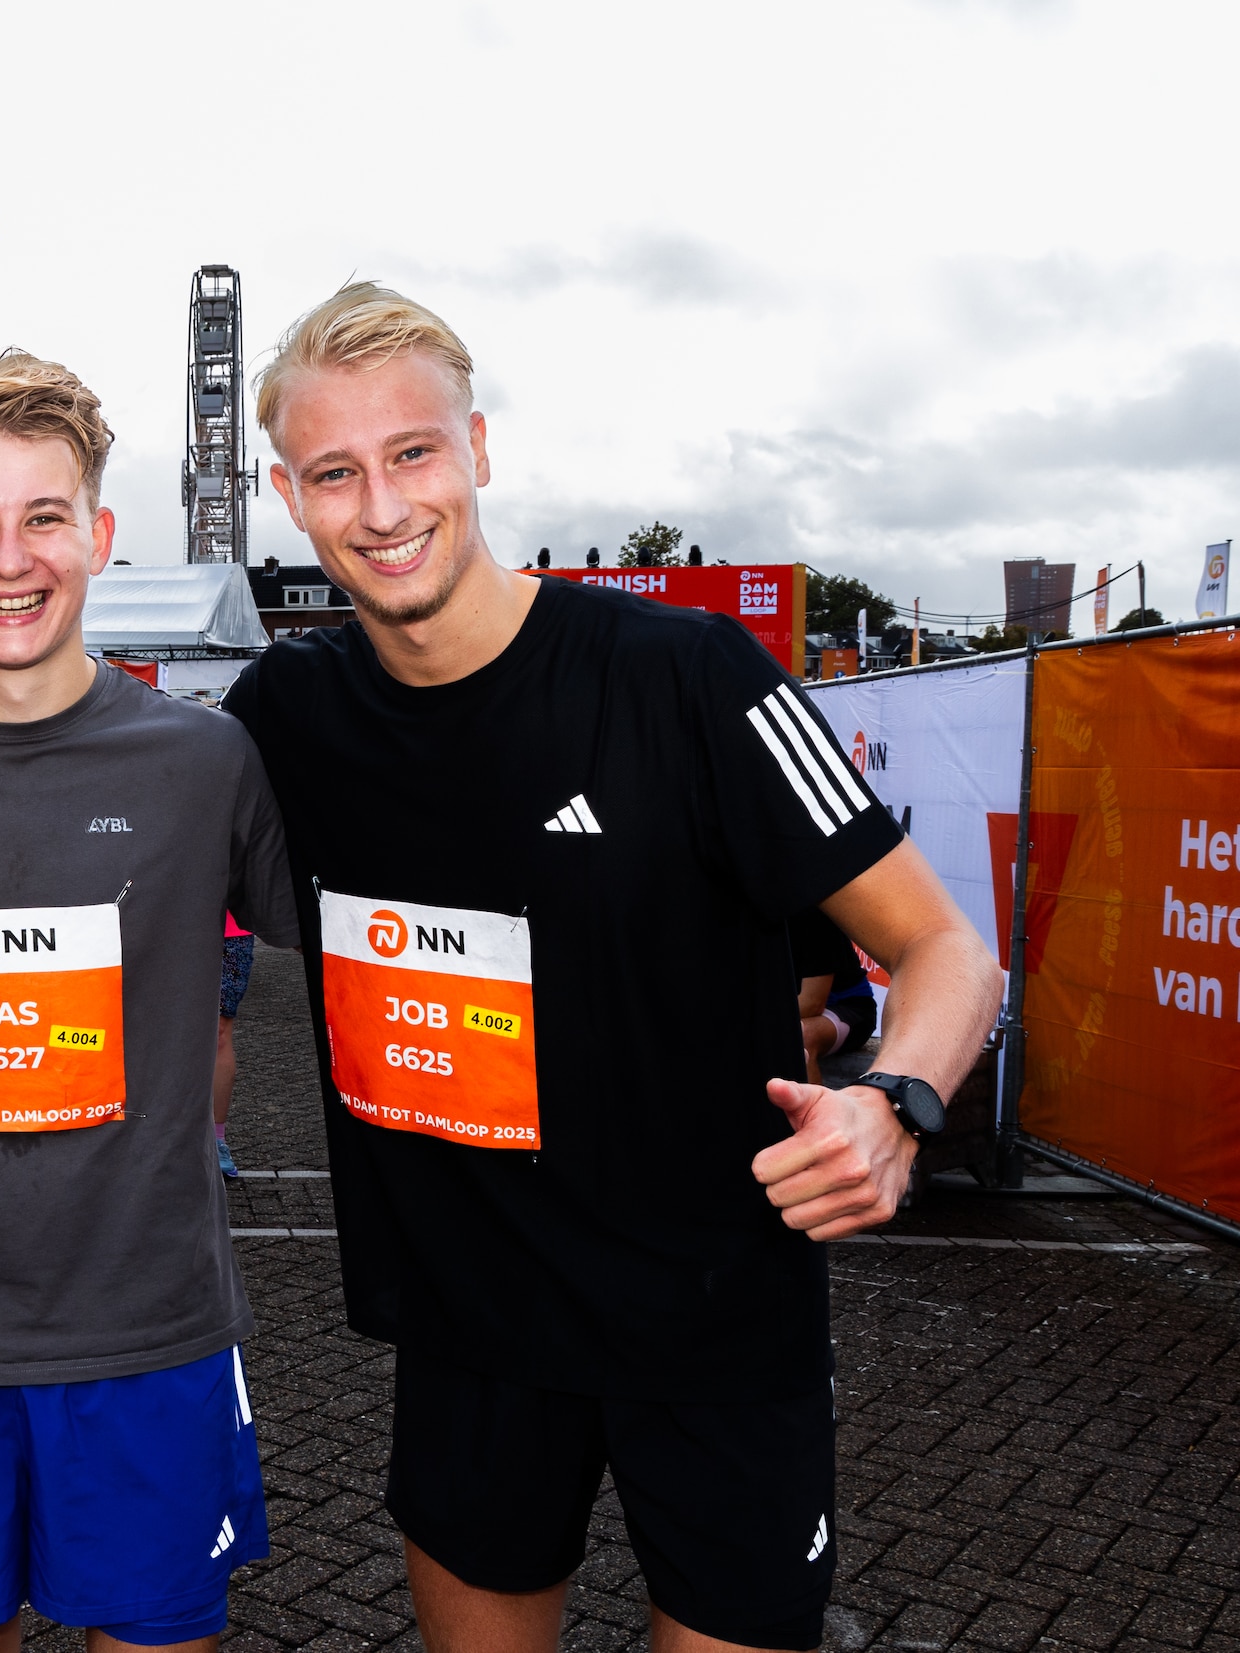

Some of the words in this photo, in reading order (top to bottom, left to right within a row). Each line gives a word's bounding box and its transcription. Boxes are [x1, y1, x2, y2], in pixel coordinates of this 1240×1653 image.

[582, 575, 666, 593] FINISH
[739, 583, 778, 595] DAM
[739, 595, 778, 606] DAM
[867, 742, 887, 771] NN
[2, 927, 57, 953] NN
[415, 925, 466, 955] NN
[1153, 966, 1223, 1019] van
[384, 996, 449, 1029] JOB
[471, 1012, 513, 1032] 4.002
[57, 1031, 98, 1045] 4.004
[385, 1043, 454, 1076] 6625
[1, 1107, 82, 1123] DAMLOOP
[85, 1101, 122, 1119] 2025
[353, 1096, 378, 1117] DAM
[381, 1105, 411, 1122] TOT
[415, 1110, 489, 1138] DAMLOOP
[493, 1126, 536, 1142] 2025
